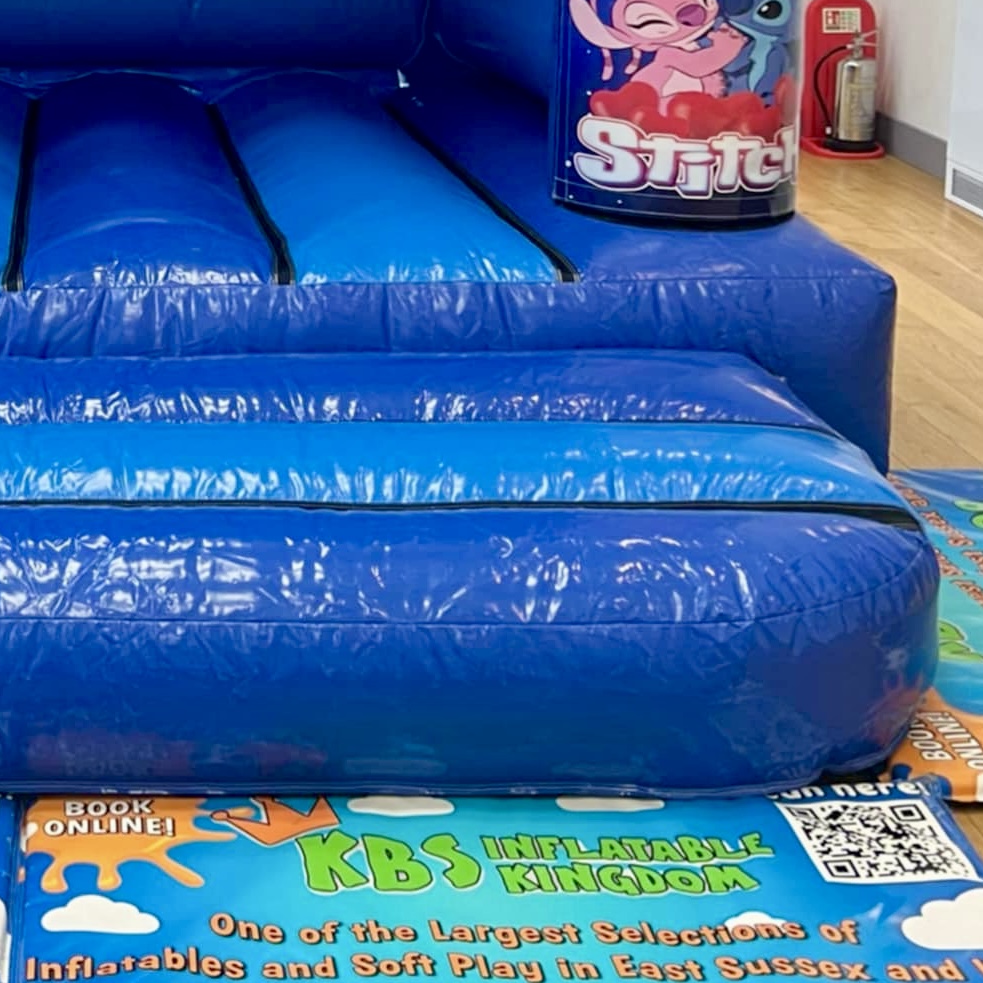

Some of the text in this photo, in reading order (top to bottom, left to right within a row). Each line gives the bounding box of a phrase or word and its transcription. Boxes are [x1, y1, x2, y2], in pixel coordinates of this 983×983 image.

[64, 799, 155, 816] BOOK
[44, 818, 176, 837] ONLINE!
[295, 829, 482, 893] KBS
[480, 833, 774, 863] INFLATABLE
[496, 863, 761, 896] KINGDOM
[210, 913, 860, 948] One of the Largest Selections of
[26, 947, 245, 981] Inflatables
[263, 956, 337, 979] and
[351, 952, 435, 976] Soft
[447, 952, 545, 983] Play
[557, 958, 601, 979] in
[610, 954, 704, 982] East
[714, 956, 871, 982] Sussex
[887, 958, 967, 982] and
